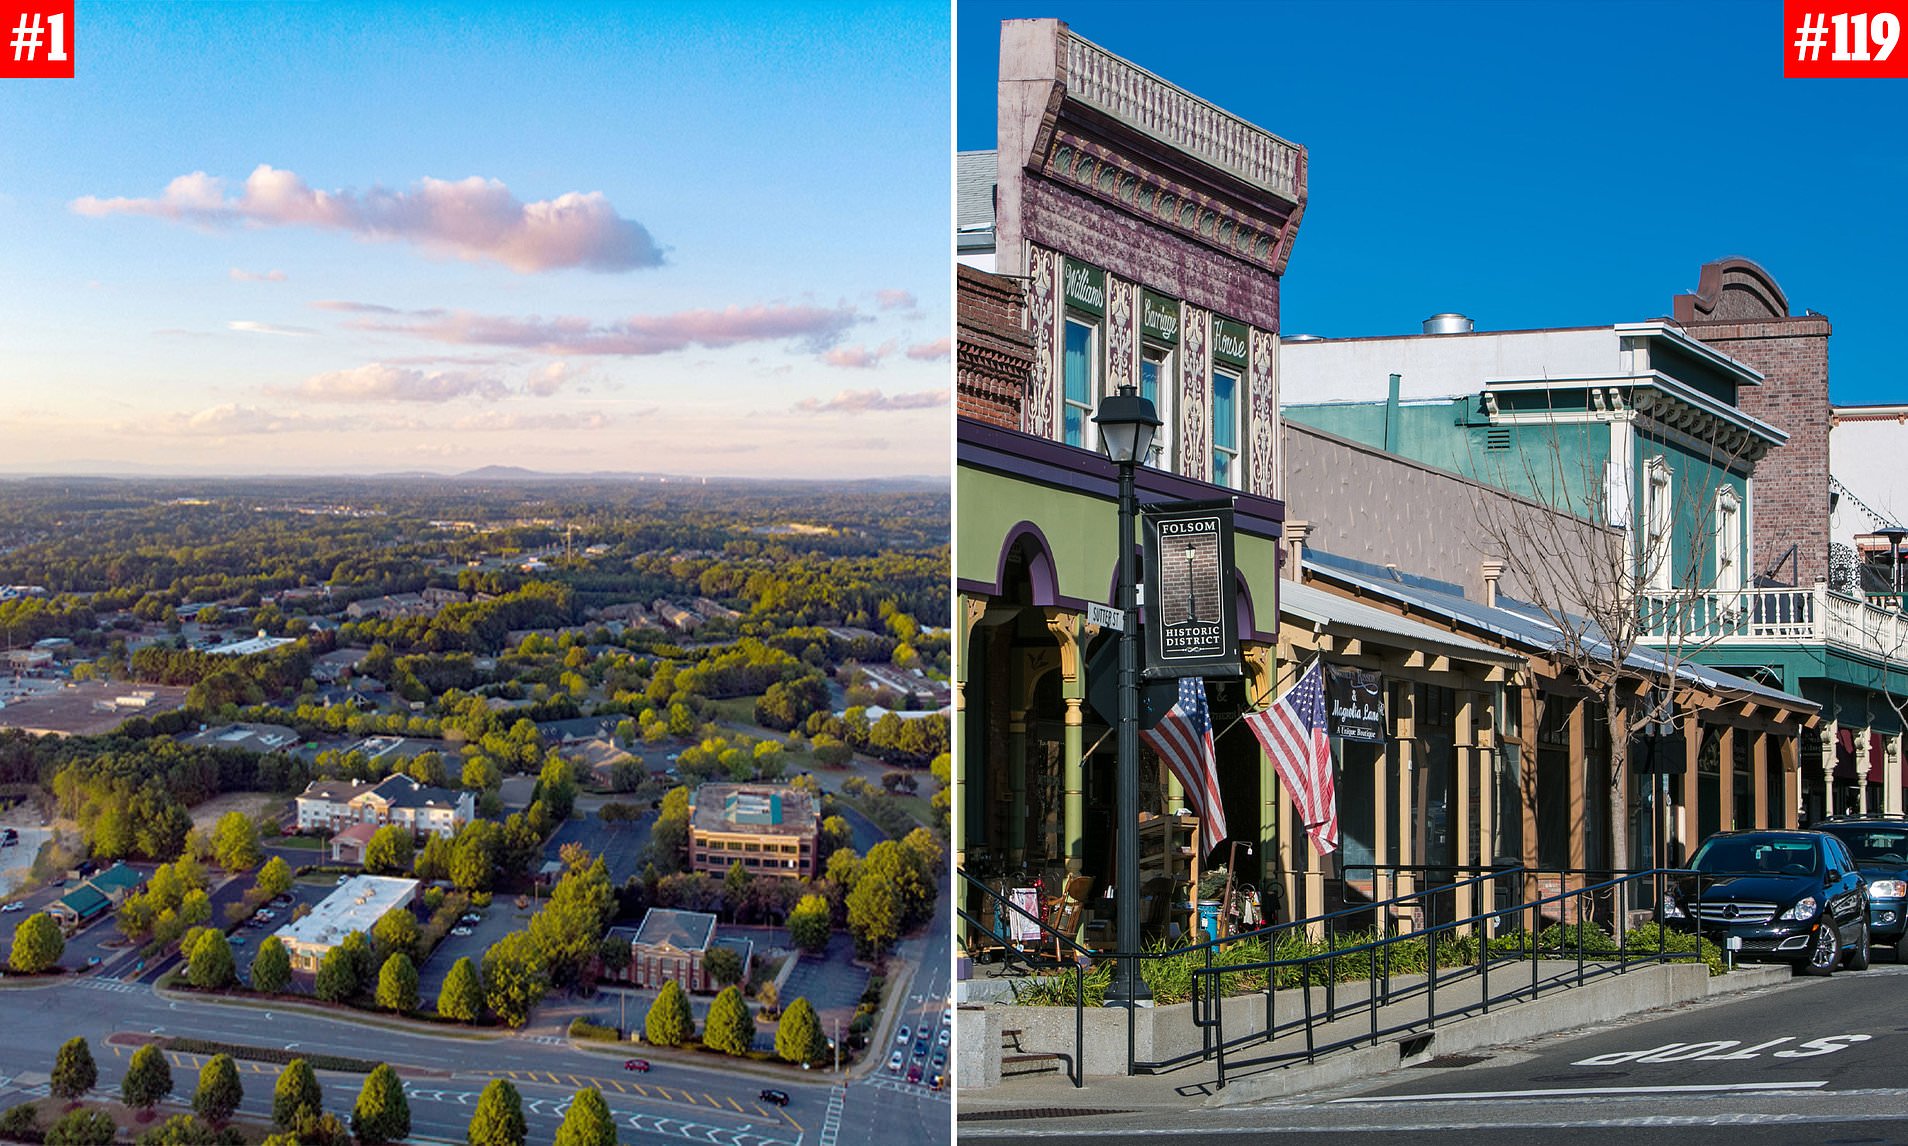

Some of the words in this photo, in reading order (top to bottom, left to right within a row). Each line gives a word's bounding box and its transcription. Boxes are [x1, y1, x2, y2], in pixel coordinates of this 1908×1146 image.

[1065, 263, 1104, 308] Williams
[1144, 298, 1178, 339] Carriage
[1214, 319, 1247, 359] House
[1162, 521, 1216, 534] FOLSOM
[1093, 606, 1112, 625] SUTTER
[1112, 611, 1120, 627] ST
[1166, 626, 1220, 637] HISTORIC
[1166, 635, 1220, 646] DISTRICT
[1332, 699, 1362, 723] Magnolia
[1362, 703, 1379, 721] Lane
[1570, 1034, 1873, 1066] STOP
